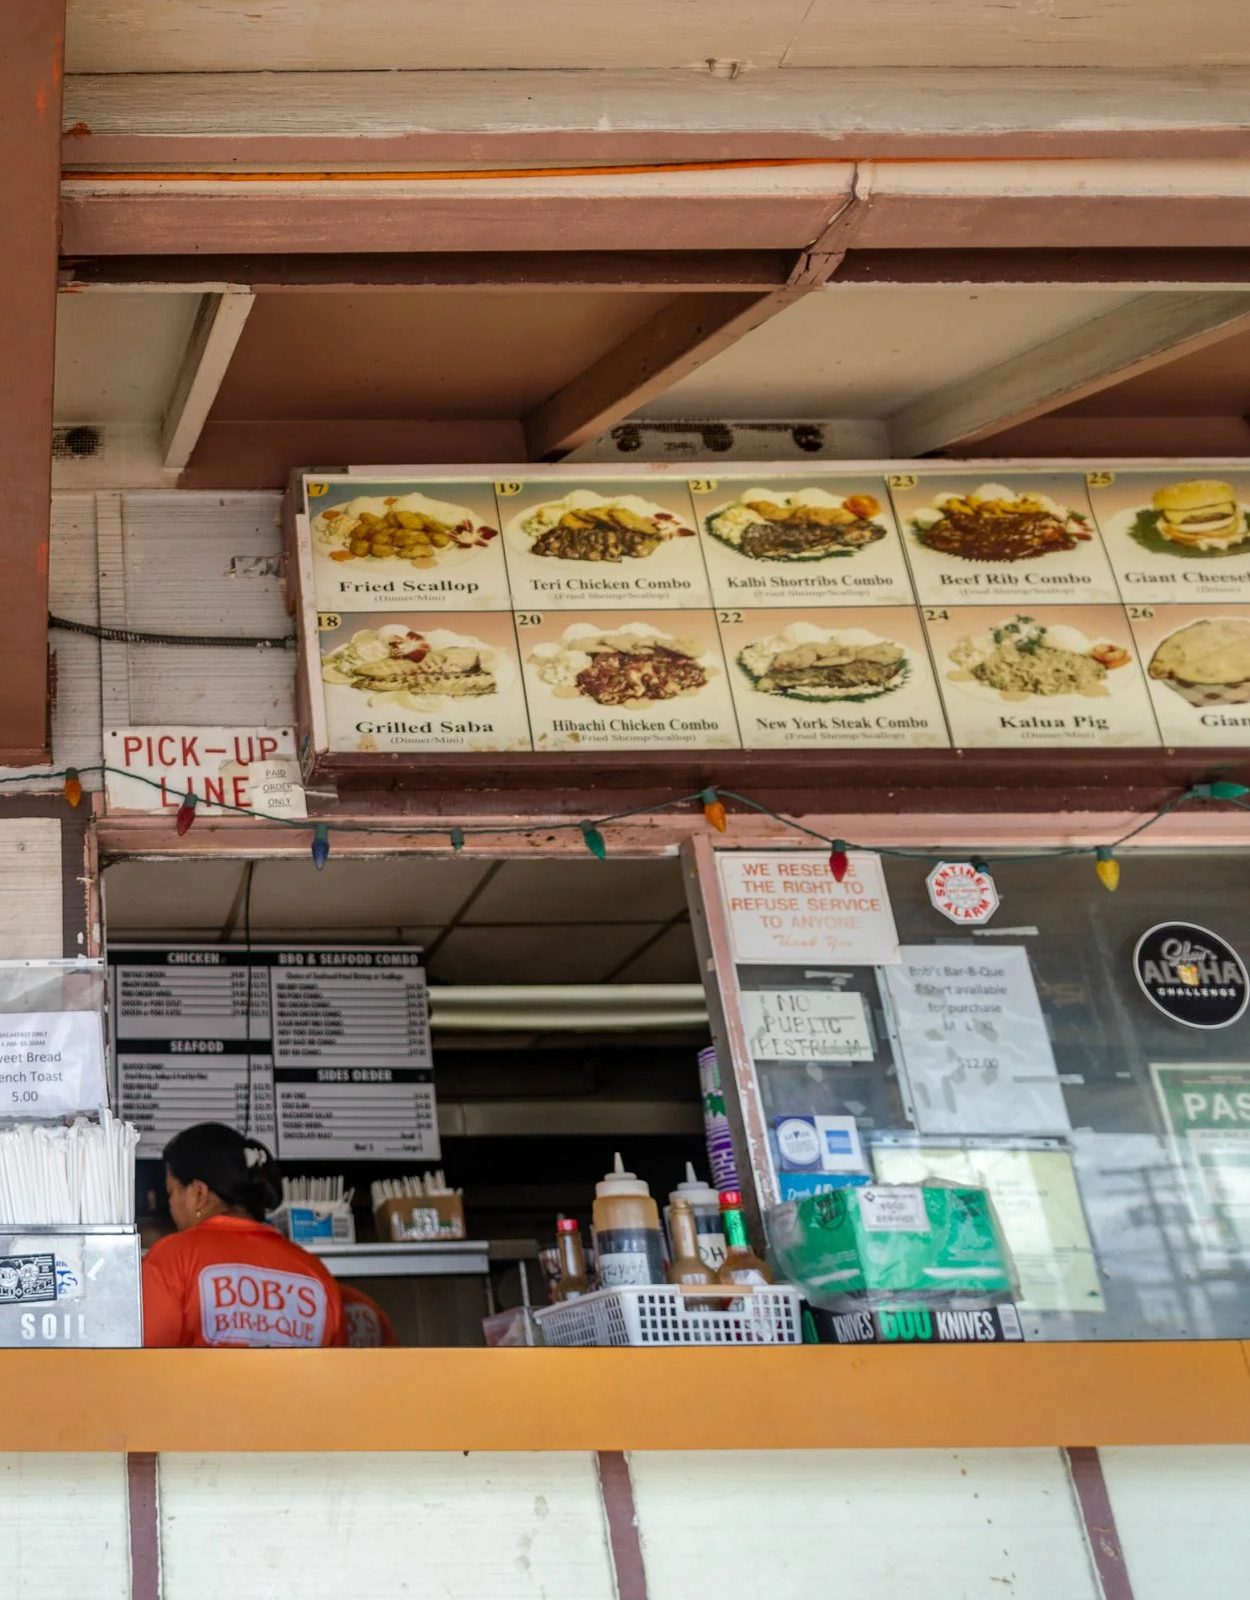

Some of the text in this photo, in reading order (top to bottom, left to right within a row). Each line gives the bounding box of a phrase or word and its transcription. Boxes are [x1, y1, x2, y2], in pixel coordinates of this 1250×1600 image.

[692, 479, 713, 490] 21
[892, 475, 915, 487] 23
[1089, 472, 1112, 484] 25
[500, 482, 520, 493] 19
[530, 577, 692, 590] Teri Chicken Combo
[727, 575, 893, 588] Kalbi Shortribs Combo
[940, 572, 1092, 585] Beef Rib Combo
[1124, 572, 1176, 583] Giant
[339, 580, 480, 594] Fried Scallop
[720, 612, 744, 624] 22
[926, 609, 950, 621] 24
[1130, 607, 1154, 619] 26
[318, 615, 339, 628] 18
[518, 614, 542, 626] 20
[355, 720, 494, 733] Grilled Saba
[552, 718, 719, 731] Hibachi Chicken Combo
[756, 716, 928, 730] New York Steak Combo
[999, 715, 1110, 730] Kalua Pig
[123, 735, 279, 766] PICK-UP
[265, 769, 287, 778] PAID
[262, 782, 293, 793] ORDER
[268, 797, 292, 807] ONLY
[743, 864, 769, 876] WE
[742, 881, 864, 894] THE RIGHT TO
[935, 865, 989, 897] SENTINEL
[732, 898, 882, 912] REFUSE SERVICE
[943, 899, 990, 918] ALARM
[760, 915, 861, 929] TO ANYONE
[772, 934, 818, 948] Thank
[167, 952, 220, 964] CHICKEN
[278, 953, 419, 966] BBQ & SEAFOOD COMBO
[909, 966, 1005, 977] Bob's Bar-B-Que
[955, 984, 1007, 995] available
[777, 994, 810, 1012] NO
[950, 1003, 1002, 1014] purchase
[762, 1015, 842, 1034] PUBLIC
[170, 1041, 224, 1053] SEAFOOD
[27, 1051, 62, 1063] Bread
[957, 1058, 999, 1069] $12.00
[31, 1071, 63, 1082] Toast
[317, 1069, 393, 1082] SIDES ORDER
[12, 1091, 39, 1102] 5.00
[212, 1276, 317, 1319] BOB'S
[21, 1313, 89, 1340] SOIL
[214, 1311, 314, 1342] BAR-B-QUE
[879, 1300, 996, 1340] 600 KNIVES
[832, 1312, 875, 1343] KNIVES
